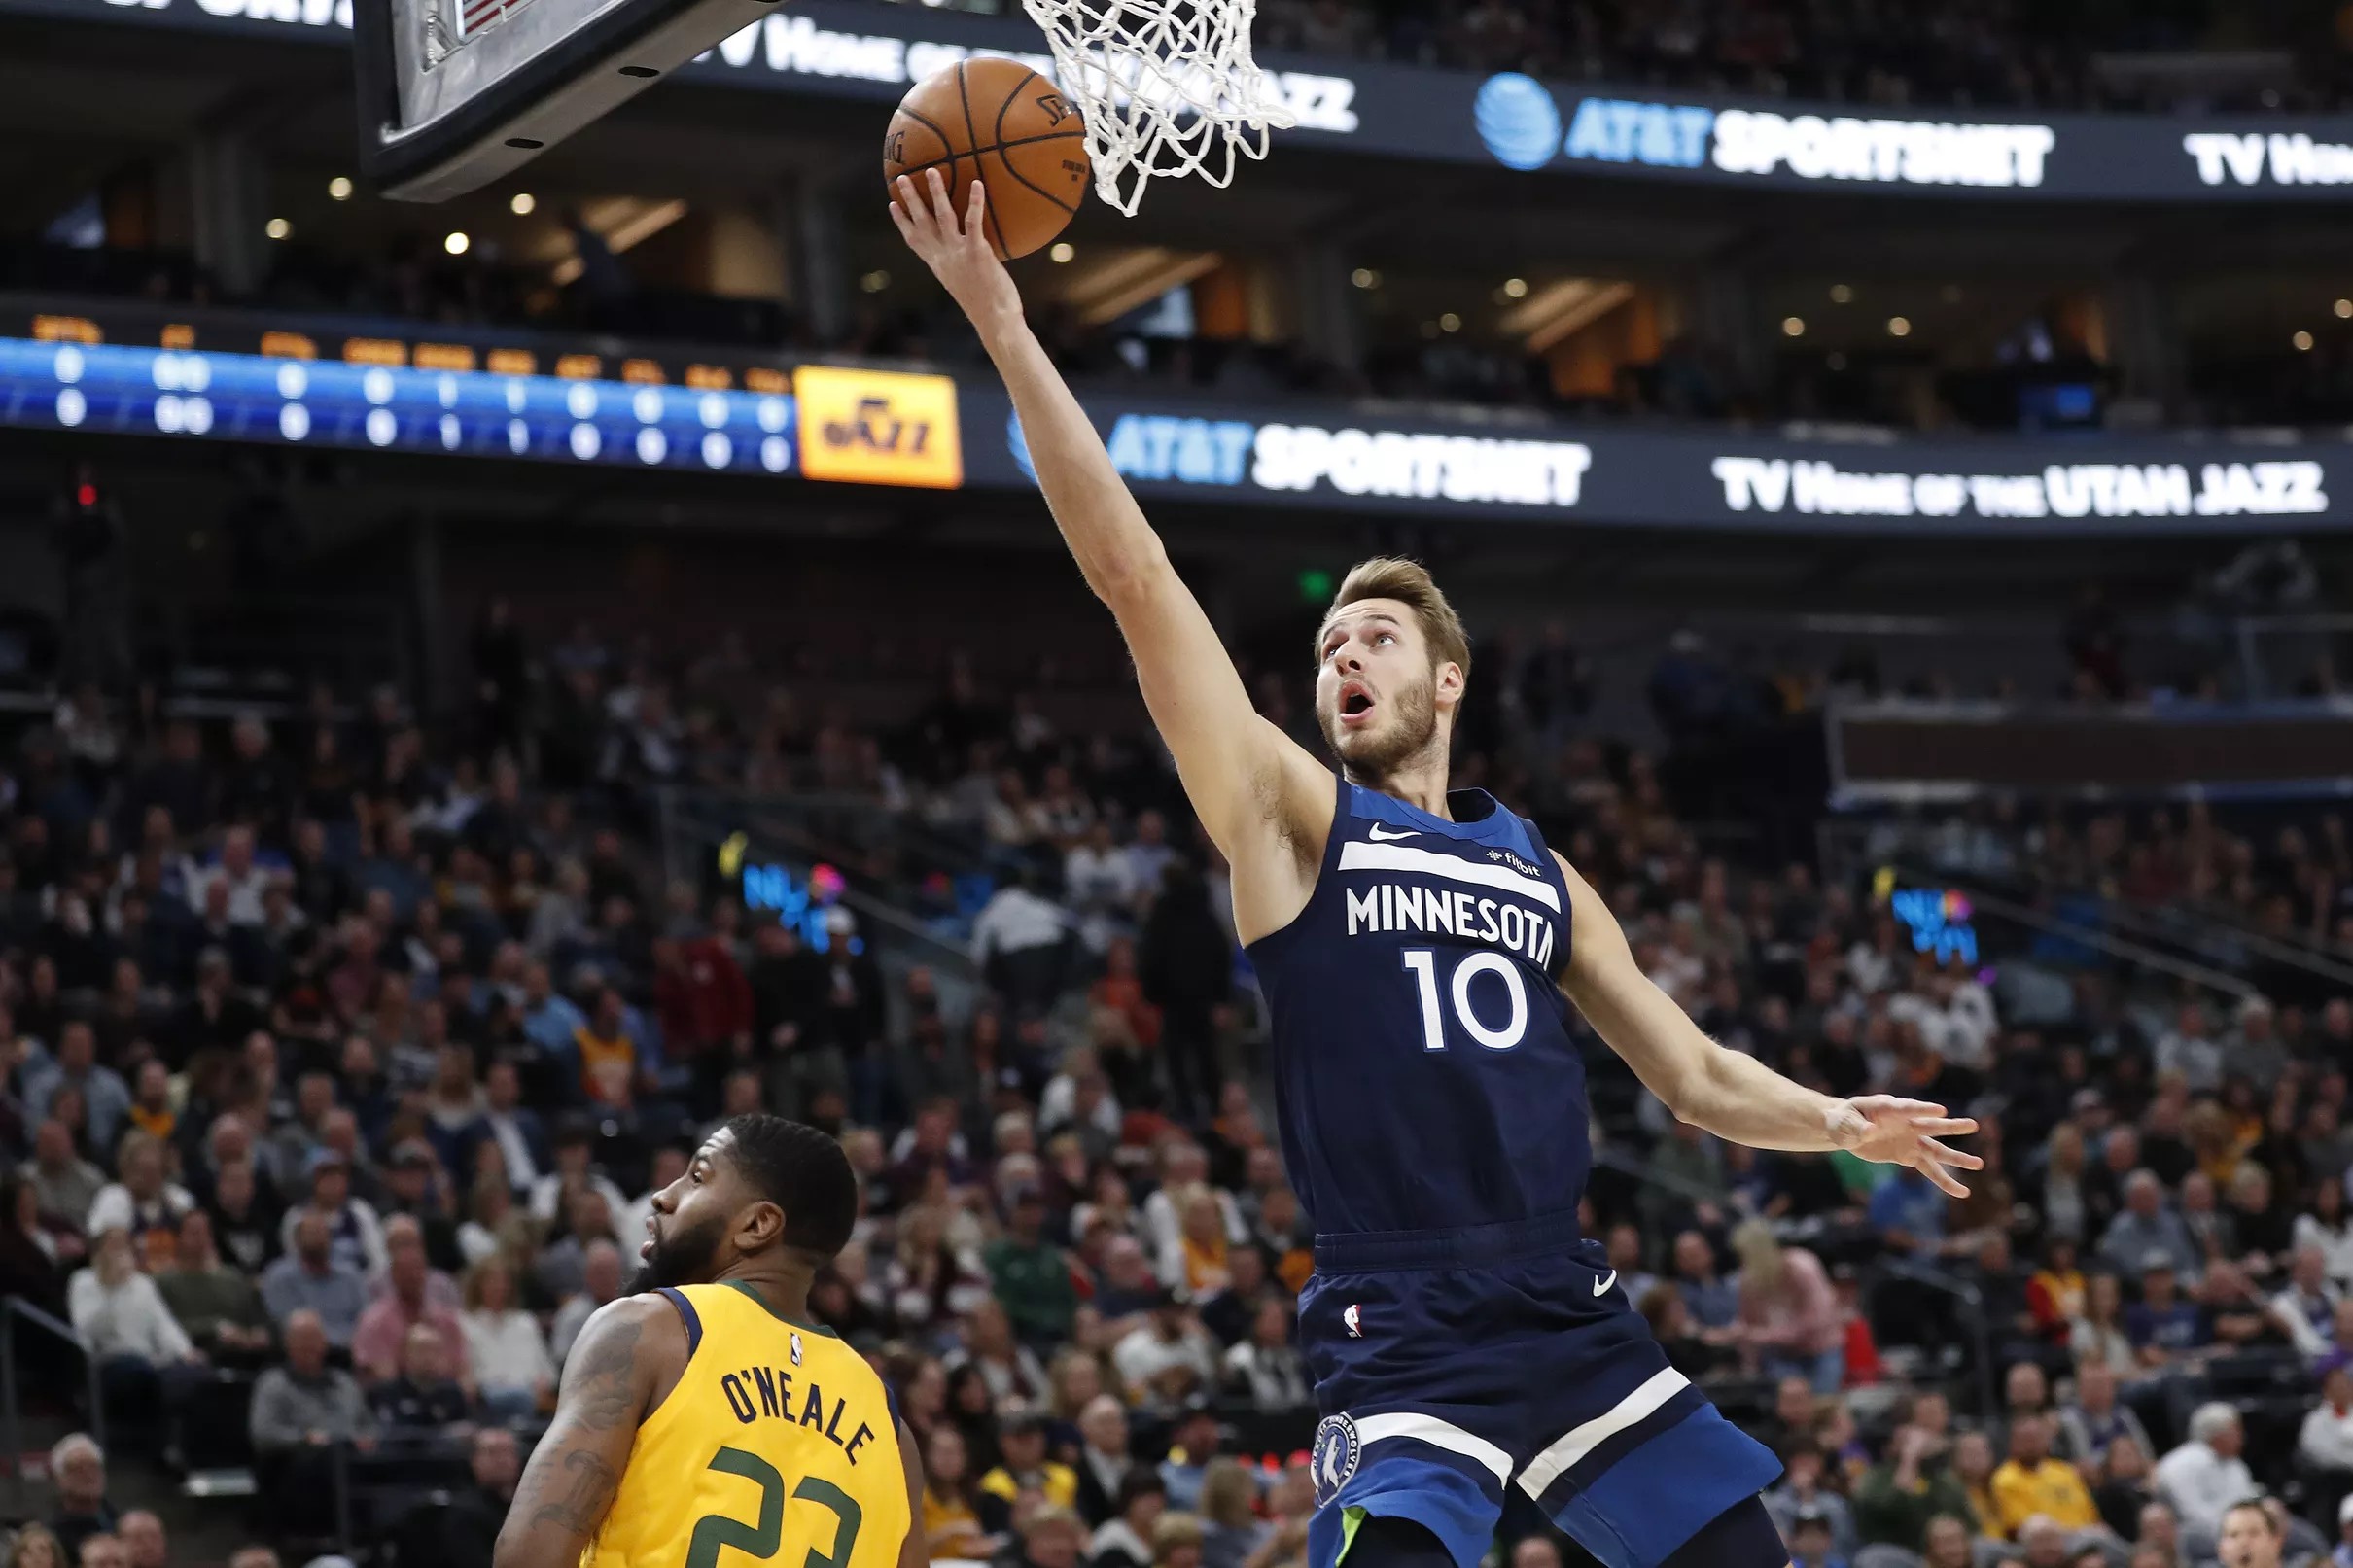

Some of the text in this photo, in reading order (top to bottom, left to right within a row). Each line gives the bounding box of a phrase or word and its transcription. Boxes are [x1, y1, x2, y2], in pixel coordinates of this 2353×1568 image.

[1565, 98, 1714, 168] AT&T
[2183, 133, 2265, 185] TV
[1712, 457, 1790, 512] TV
[2045, 464, 2192, 517] UTAH
[2193, 461, 2328, 513] JAZZ
[1504, 852, 1541, 877] fitbit
[1346, 884, 1554, 972] MINNESOTA
[1400, 947, 1529, 1053] 10
[720, 1366, 875, 1467] O'NEALE
[685, 1446, 862, 1568] 23
